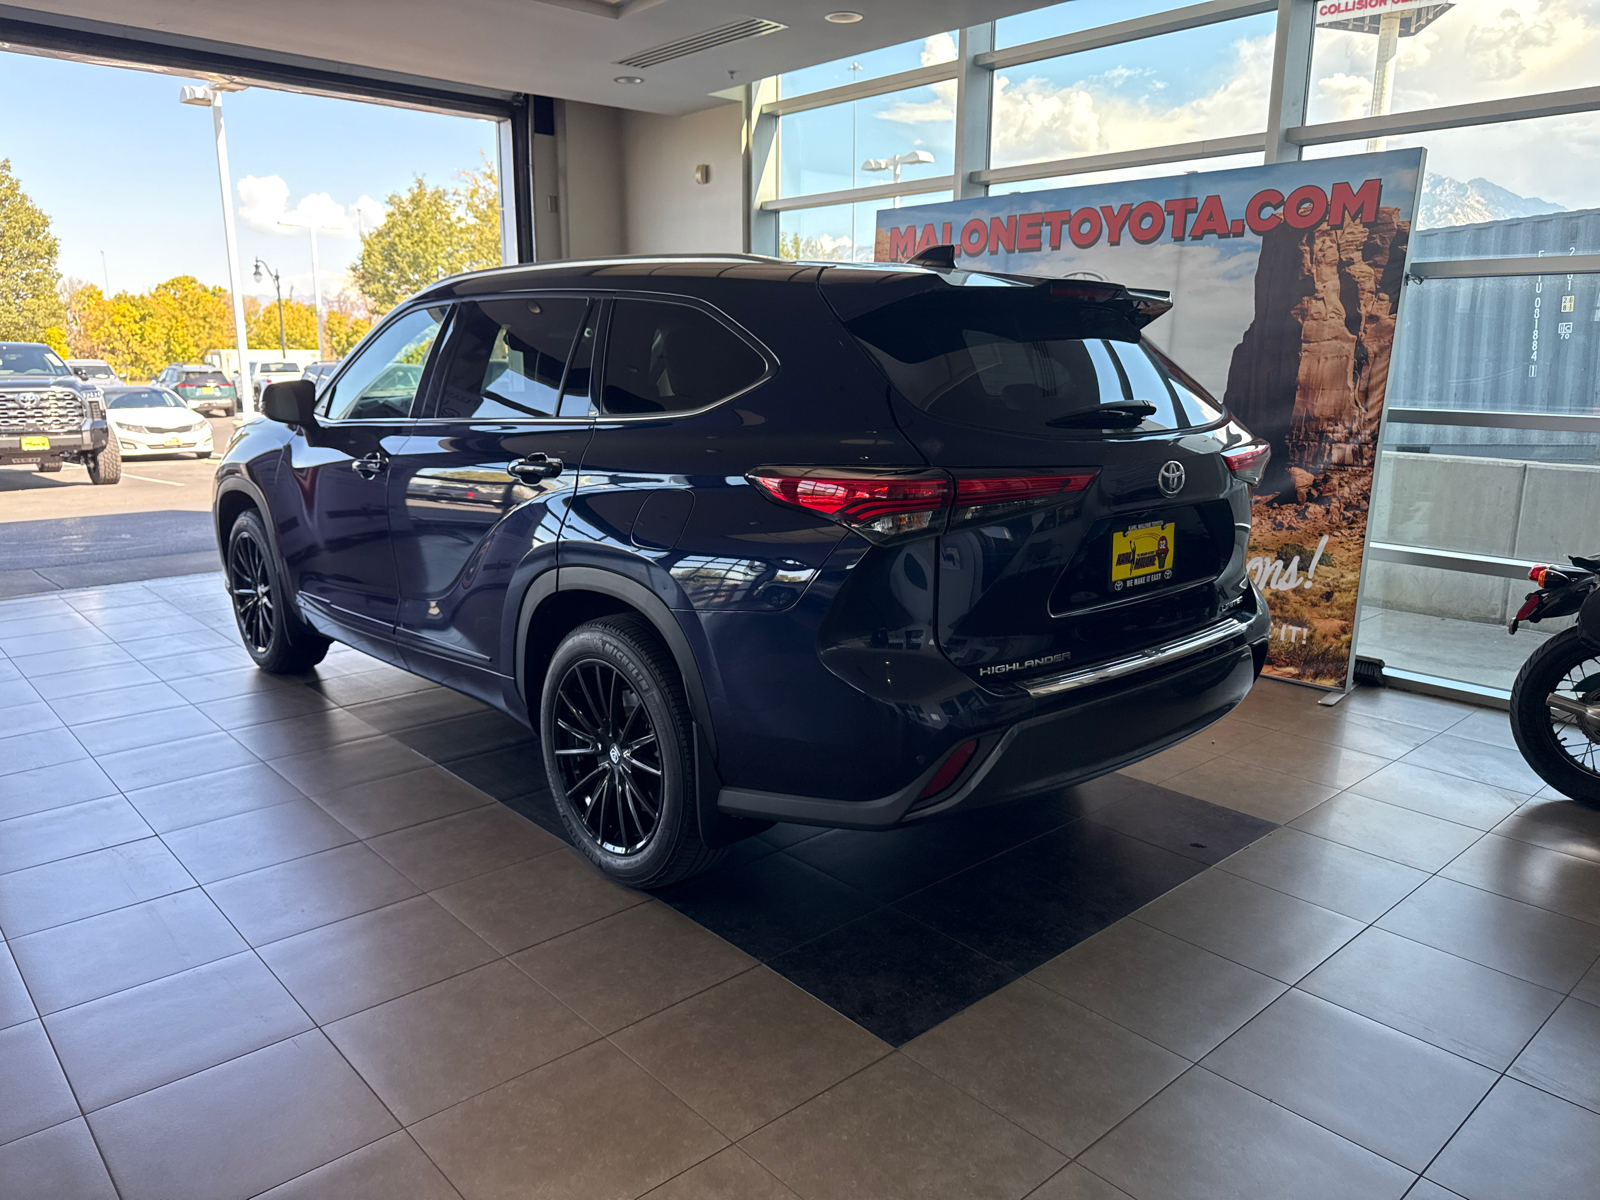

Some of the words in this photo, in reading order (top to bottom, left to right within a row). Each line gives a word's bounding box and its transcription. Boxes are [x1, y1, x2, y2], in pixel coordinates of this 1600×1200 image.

[1319, 0, 1387, 16] COLLISION
[1159, 540, 1166, 549] 32
[1126, 579, 1133, 587] WE
[1134, 577, 1146, 586] MAKE
[1146, 575, 1151, 583] IT
[1151, 573, 1162, 581] EASY
[1280, 624, 1308, 645] IT!
[604, 643, 650, 692] MICHELIN
[979, 651, 1072, 676] HIGHLANDER
